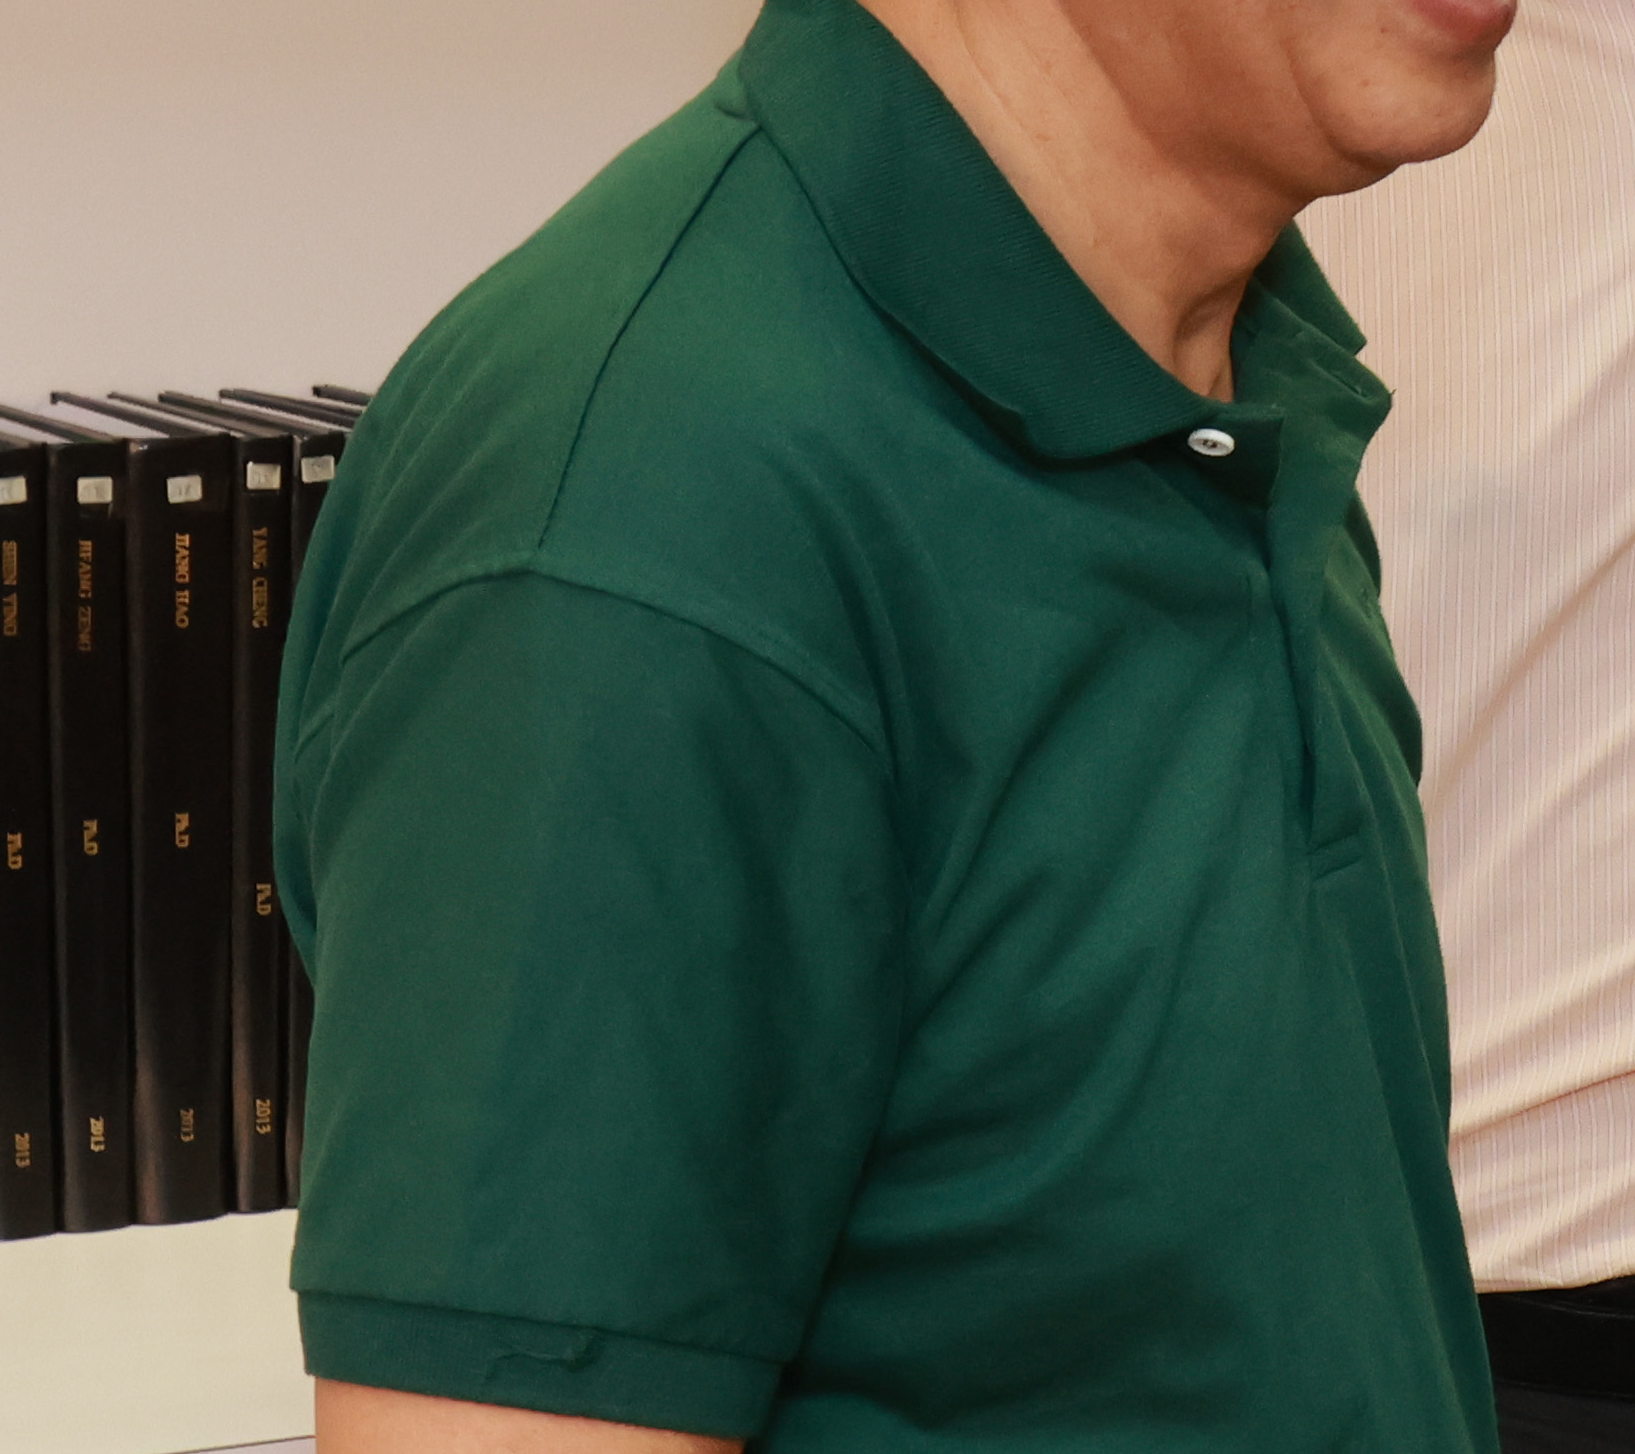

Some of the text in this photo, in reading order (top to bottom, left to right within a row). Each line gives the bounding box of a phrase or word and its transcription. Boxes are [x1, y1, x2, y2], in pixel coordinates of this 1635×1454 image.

[175, 589, 191, 629] HAO
[83, 819, 99, 856] Ph.D
[175, 812, 190, 848] Ph.D
[252, 527, 272, 1134] YANG CHENG Ph.D 2013
[7, 832, 23, 870] Ph.D
[15, 1133, 31, 1168] 2013
